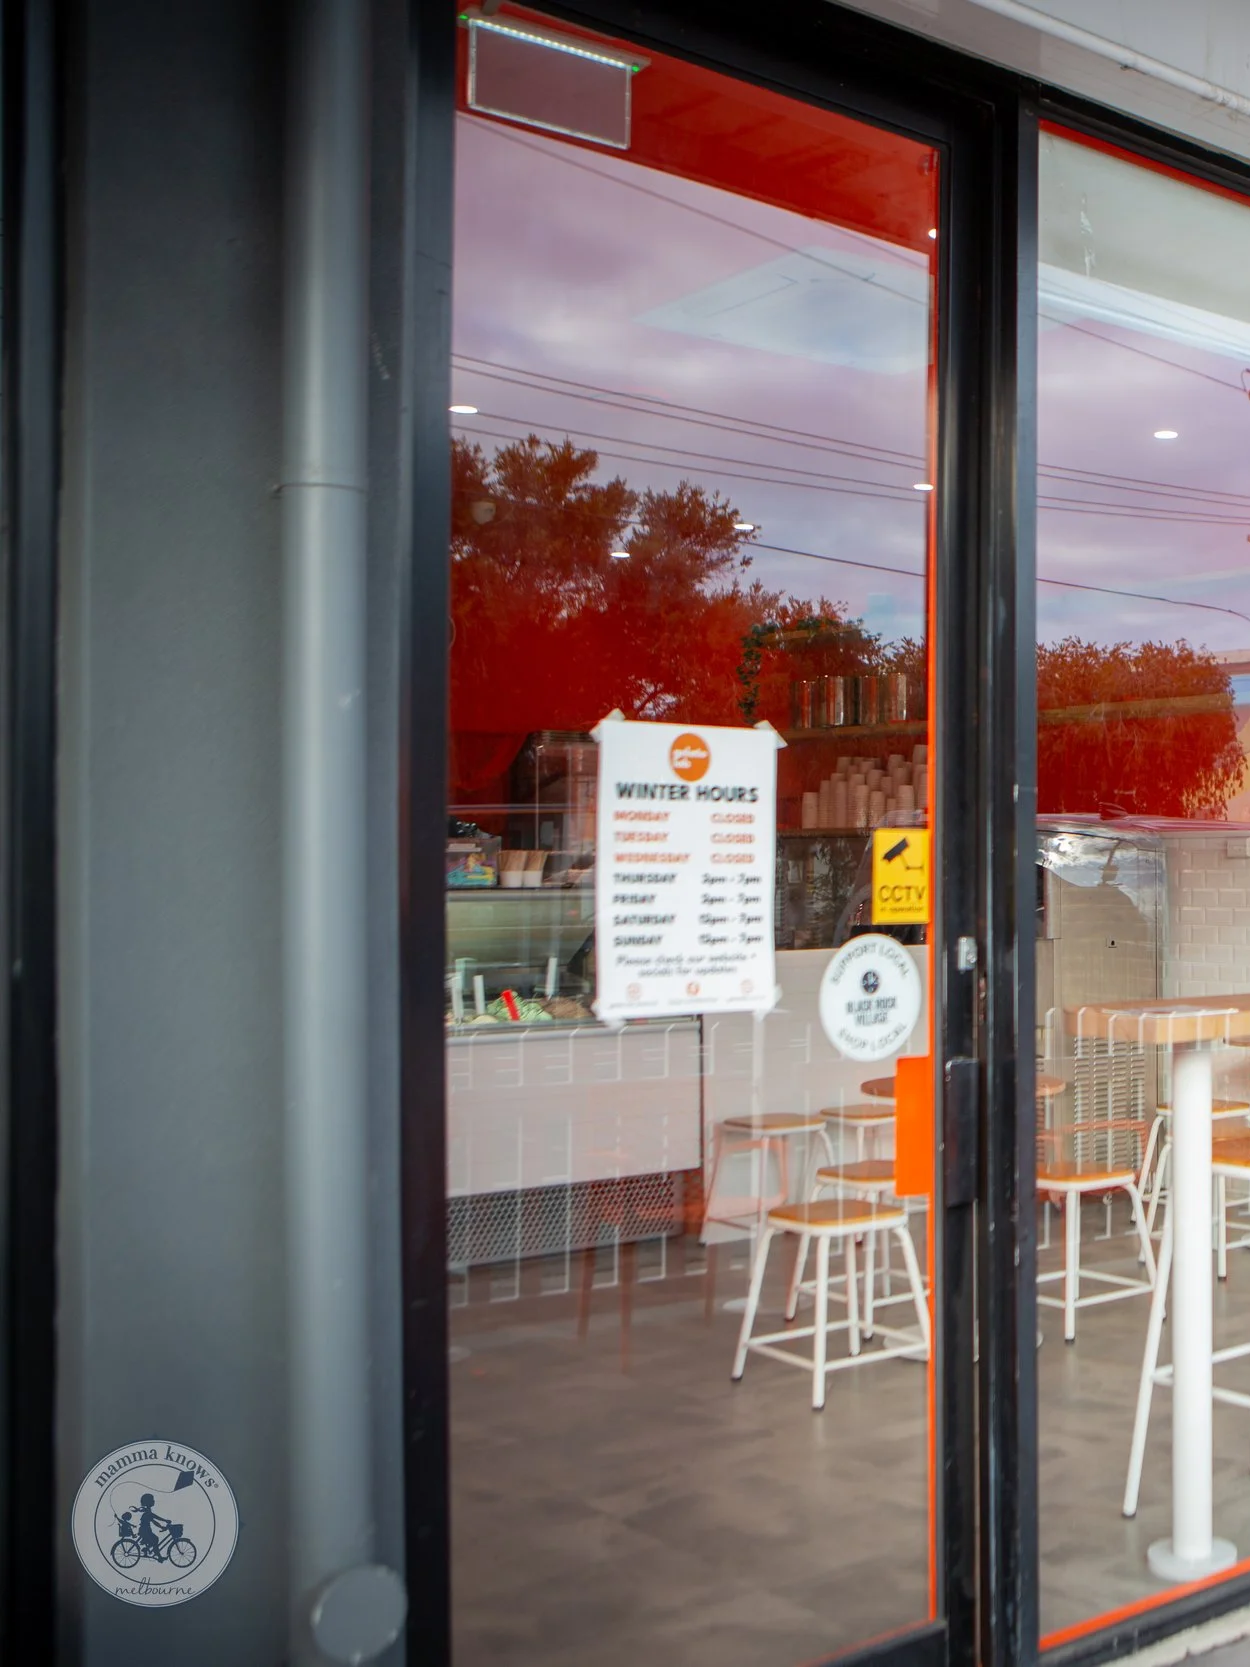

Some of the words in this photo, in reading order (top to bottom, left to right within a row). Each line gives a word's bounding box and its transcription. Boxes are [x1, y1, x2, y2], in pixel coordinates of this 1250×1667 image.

[616, 782, 690, 800] WINTER
[696, 786, 759, 802] HOURS
[613, 811, 670, 821] MONDAY
[710, 813, 755, 824] CLOSED
[614, 831, 668, 842] TUESDAY
[710, 834, 755, 844] CLOSED
[614, 853, 691, 863] WEDNESDAY
[710, 853, 755, 864] CLOSED
[613, 872, 677, 884] THURSDAY
[612, 893, 656, 904] FRIDAY
[878, 884, 926, 903] CCTV
[613, 914, 677, 926] SATURDAY
[613, 935, 663, 947] SUNDAY
[831, 943, 877, 985] SUPPORT
[878, 944, 909, 979] LOCAL
